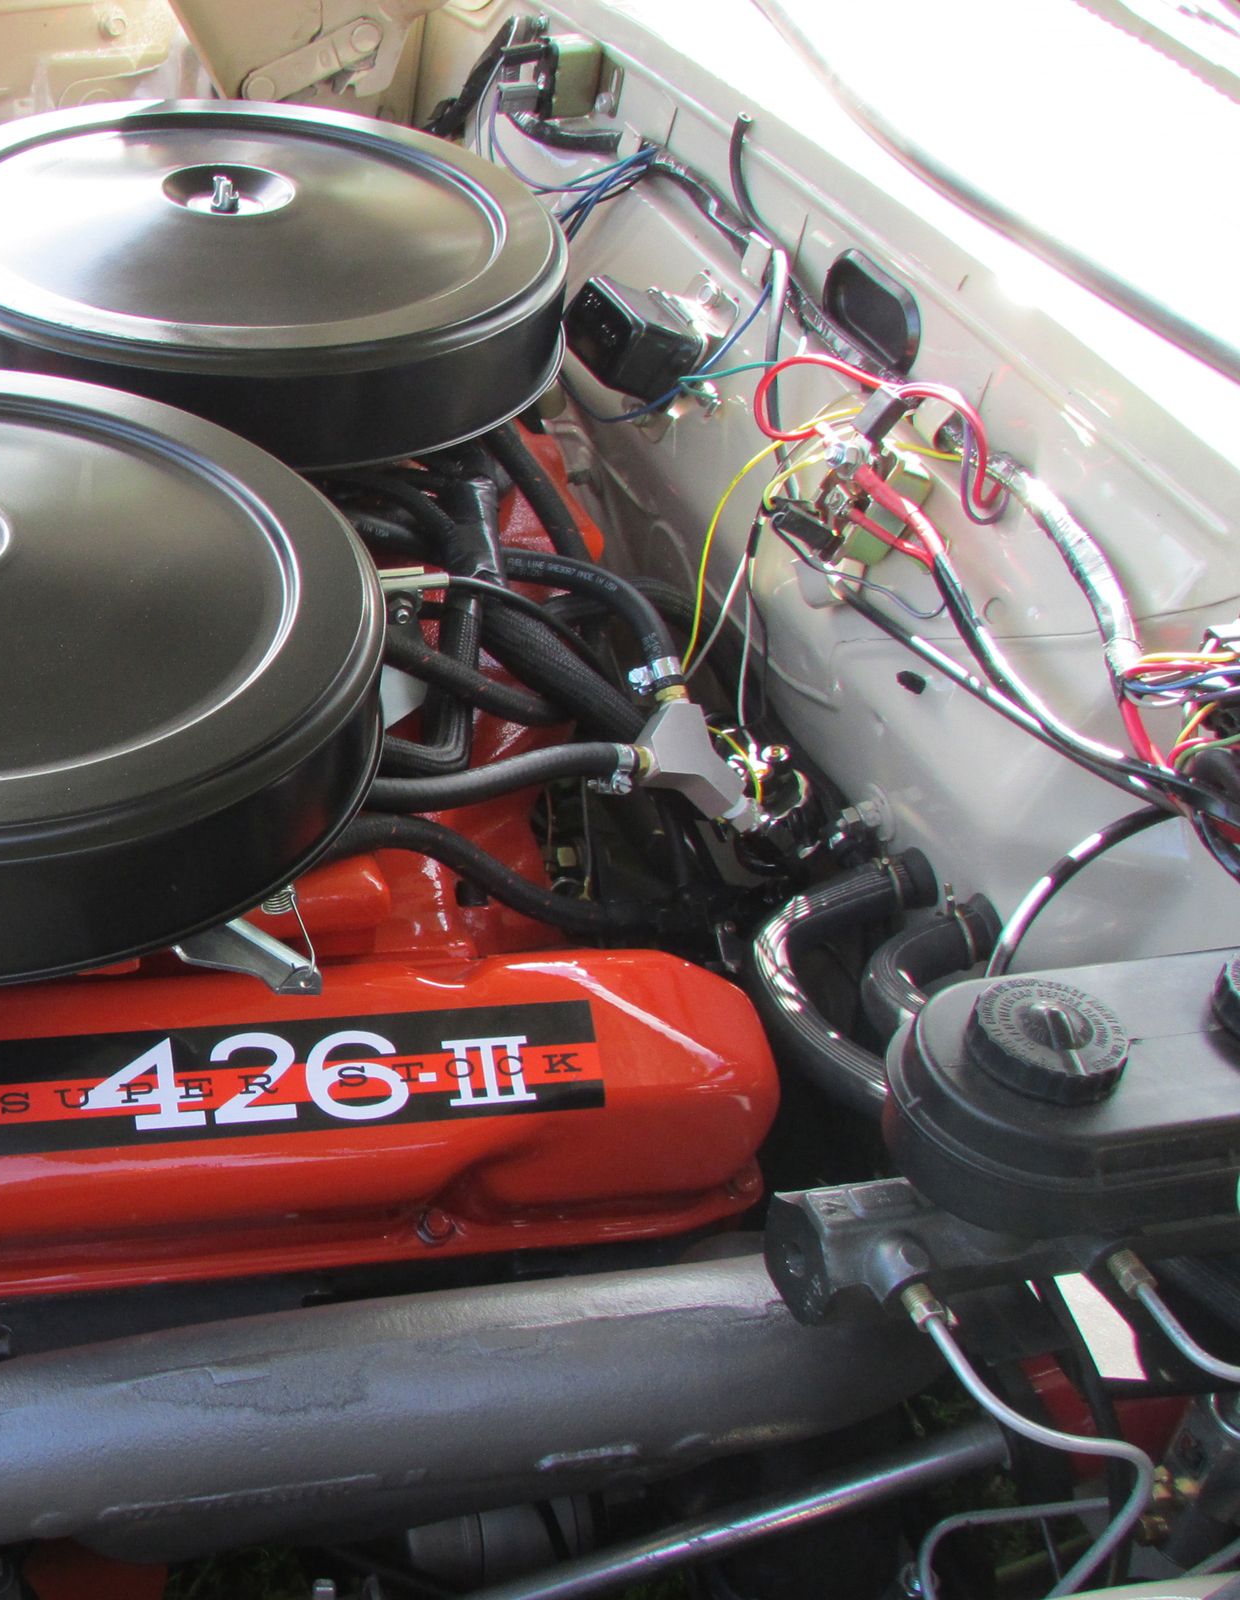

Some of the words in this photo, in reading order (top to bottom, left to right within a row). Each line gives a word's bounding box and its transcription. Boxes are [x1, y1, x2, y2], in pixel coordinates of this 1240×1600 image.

[528, 560, 545, 570] LINE
[0, 1073, 279, 1115] SUPER
[337, 1053, 582, 1087] STOCK
